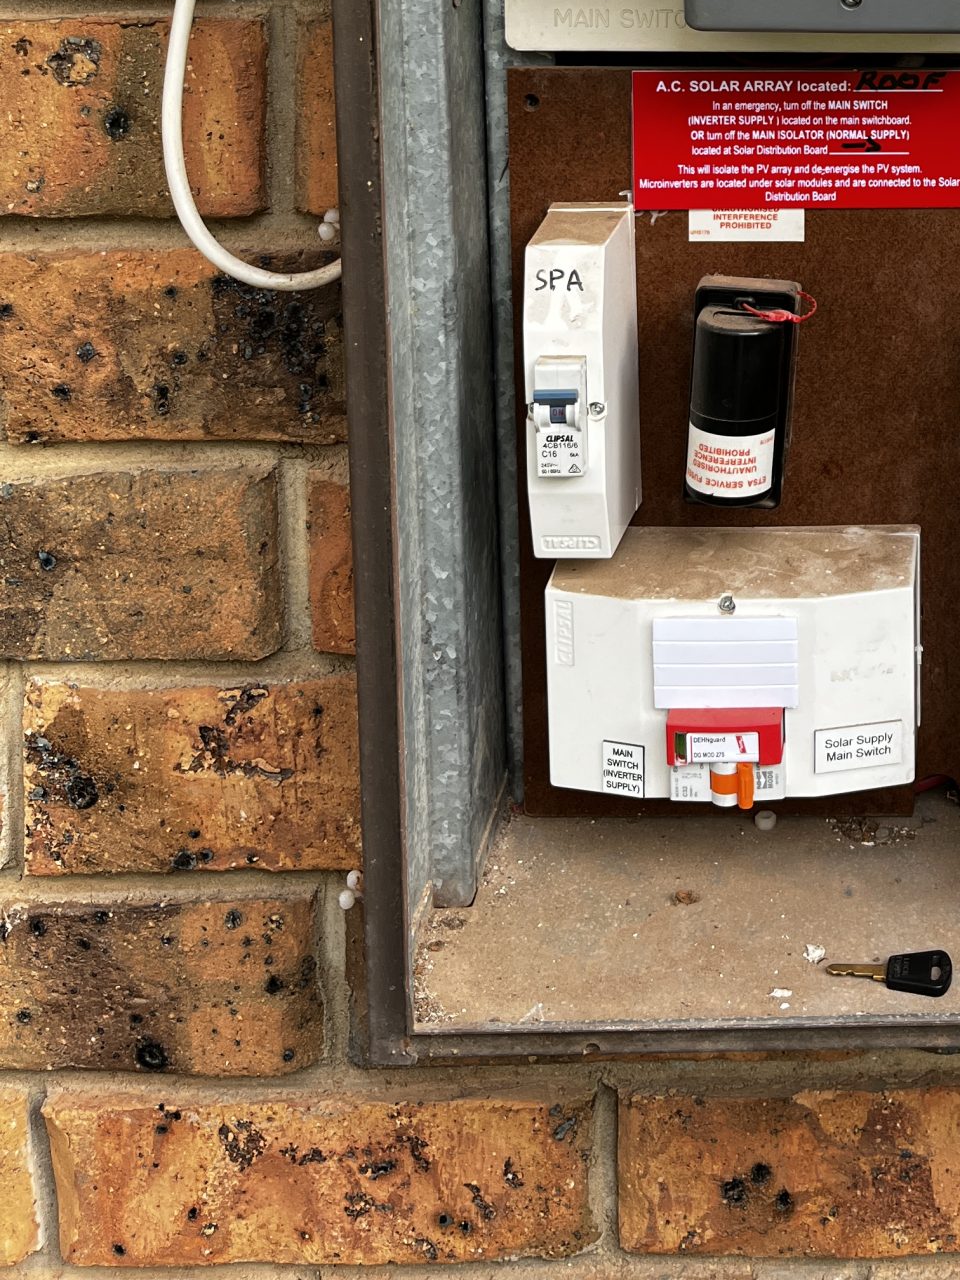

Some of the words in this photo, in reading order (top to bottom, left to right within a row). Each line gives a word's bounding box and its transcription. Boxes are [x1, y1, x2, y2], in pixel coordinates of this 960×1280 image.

[553, 7, 610, 29] MAIN
[620, 8, 687, 29] SWITC
[656, 80, 686, 93] A.C.
[689, 80, 740, 93] SOLAR
[743, 80, 793, 93] ARRAY
[797, 79, 852, 93] located:
[855, 71, 947, 91] ROOF
[712, 100, 721, 110] In
[722, 102, 733, 110] an
[734, 102, 782, 113] emergency,
[783, 100, 800, 110] turn
[801, 100, 812, 110] off
[813, 100, 826, 110] the
[828, 100, 851, 110] MAIN
[853, 100, 888, 110] SWITCH
[688, 115, 736, 127] (INVERTER
[738, 115, 775, 126] SUPPLY
[781, 115, 811, 126] located
[812, 117, 823, 125] on
[825, 115, 838, 125] the
[840, 115, 860, 125] main
[861, 114, 912, 126] switchboard.
[690, 130, 705, 141] OR
[706, 131, 722, 140] turn
[724, 130, 736, 140] off
[737, 130, 750, 140] the
[752, 130, 775, 140] MAIN
[777, 130, 824, 140] ISOLATOR
[826, 129, 868, 141] (NORMAL
[870, 129, 910, 141] SUPPLY)
[691, 144, 721, 155] located
[723, 145, 732, 155] at
[733, 145, 755, 155] Solar
[756, 144, 801, 155] Distribution
[803, 144, 829, 155] Board
[713, 213, 778, 221] INTERFERENCE
[534, 268, 585, 293] SPA
[552, 408, 565, 417] ON
[546, 434, 574, 442] CLIPSAL
[541, 450, 557, 458] C16
[698, 443, 751, 457] PROHIBITED
[694, 449, 757, 466] INTERFERENCE
[692, 458, 757, 475] UNAUTHORISED
[705, 477, 744, 489] SERVICE
[747, 475, 767, 487] ETSA
[556, 602, 573, 664] CLIPSAL
[824, 738, 854, 749] Solar
[856, 732, 893, 745] Supply
[612, 747, 633, 759] MAIN
[826, 750, 853, 762] Main
[855, 745, 892, 758] Switch
[607, 758, 639, 770] SWITCH
[603, 768, 643, 782] (INVERTER
[606, 780, 641, 794] SUPPLY)
